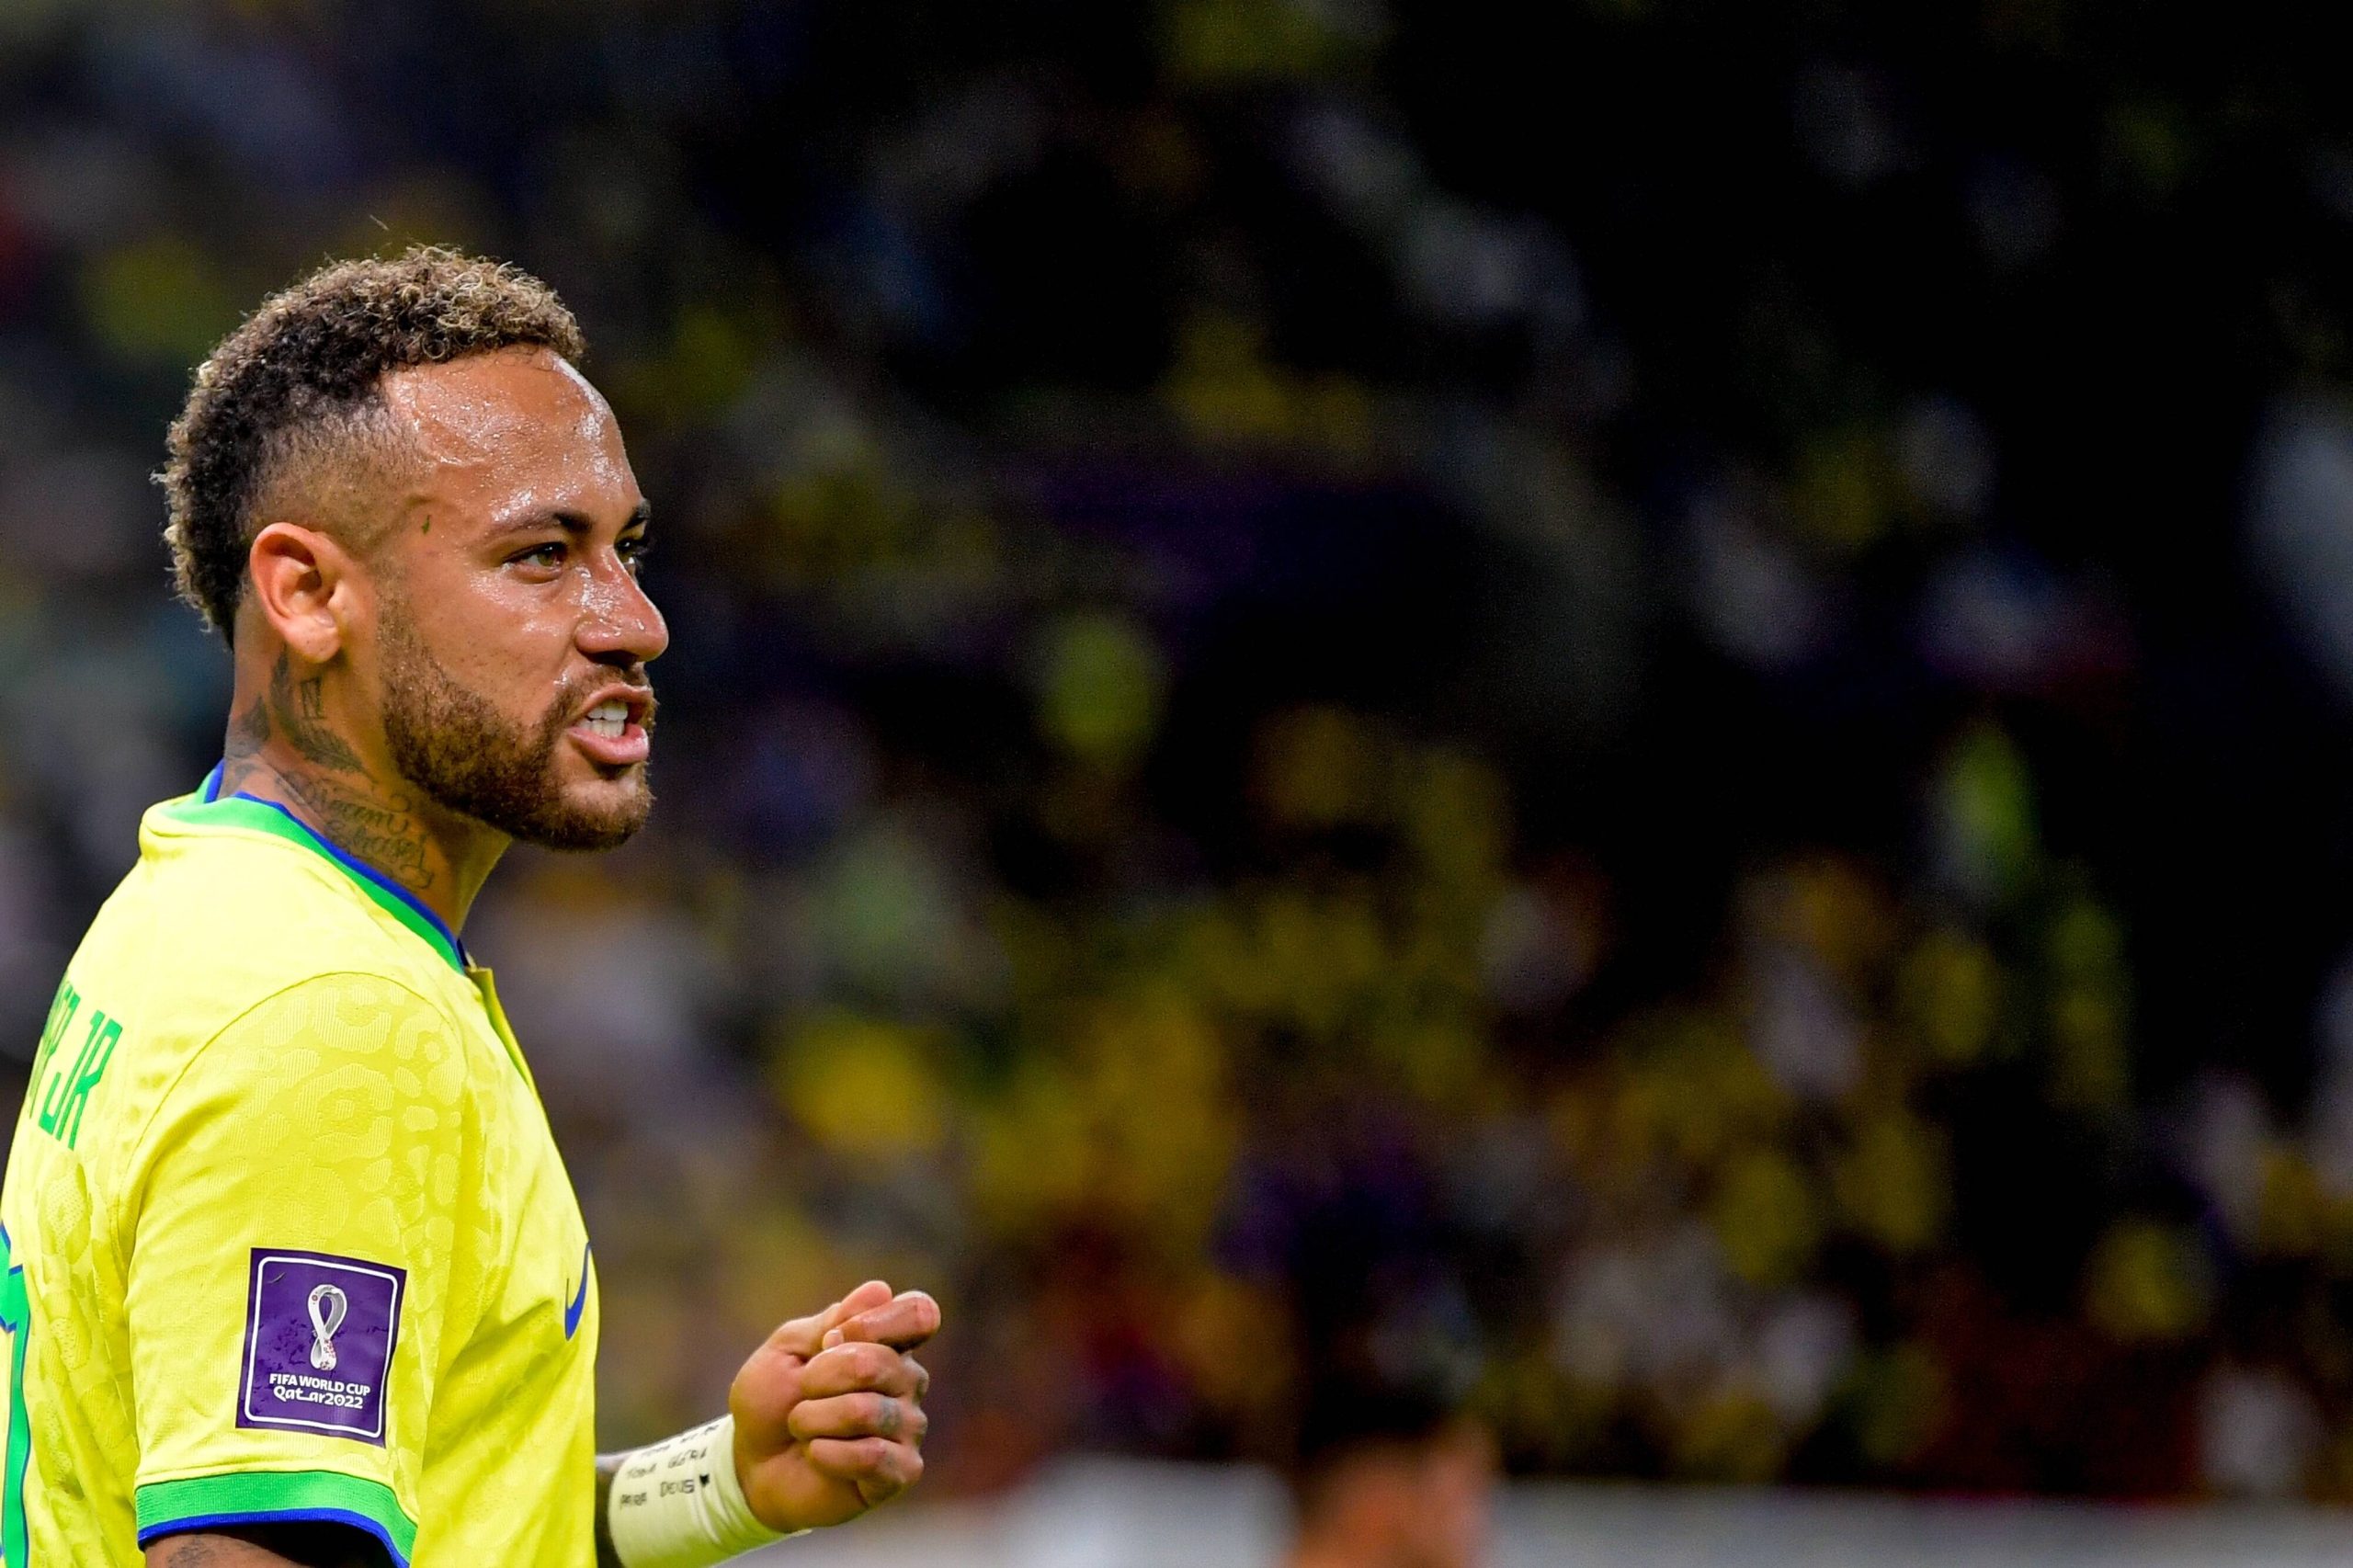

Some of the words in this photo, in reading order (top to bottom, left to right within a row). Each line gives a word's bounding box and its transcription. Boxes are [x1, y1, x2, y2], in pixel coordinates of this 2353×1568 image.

[39, 1009, 123, 1152] JR
[268, 1372, 298, 1386] FIFA
[298, 1375, 345, 1393] WORLD
[346, 1382, 370, 1397] CUP
